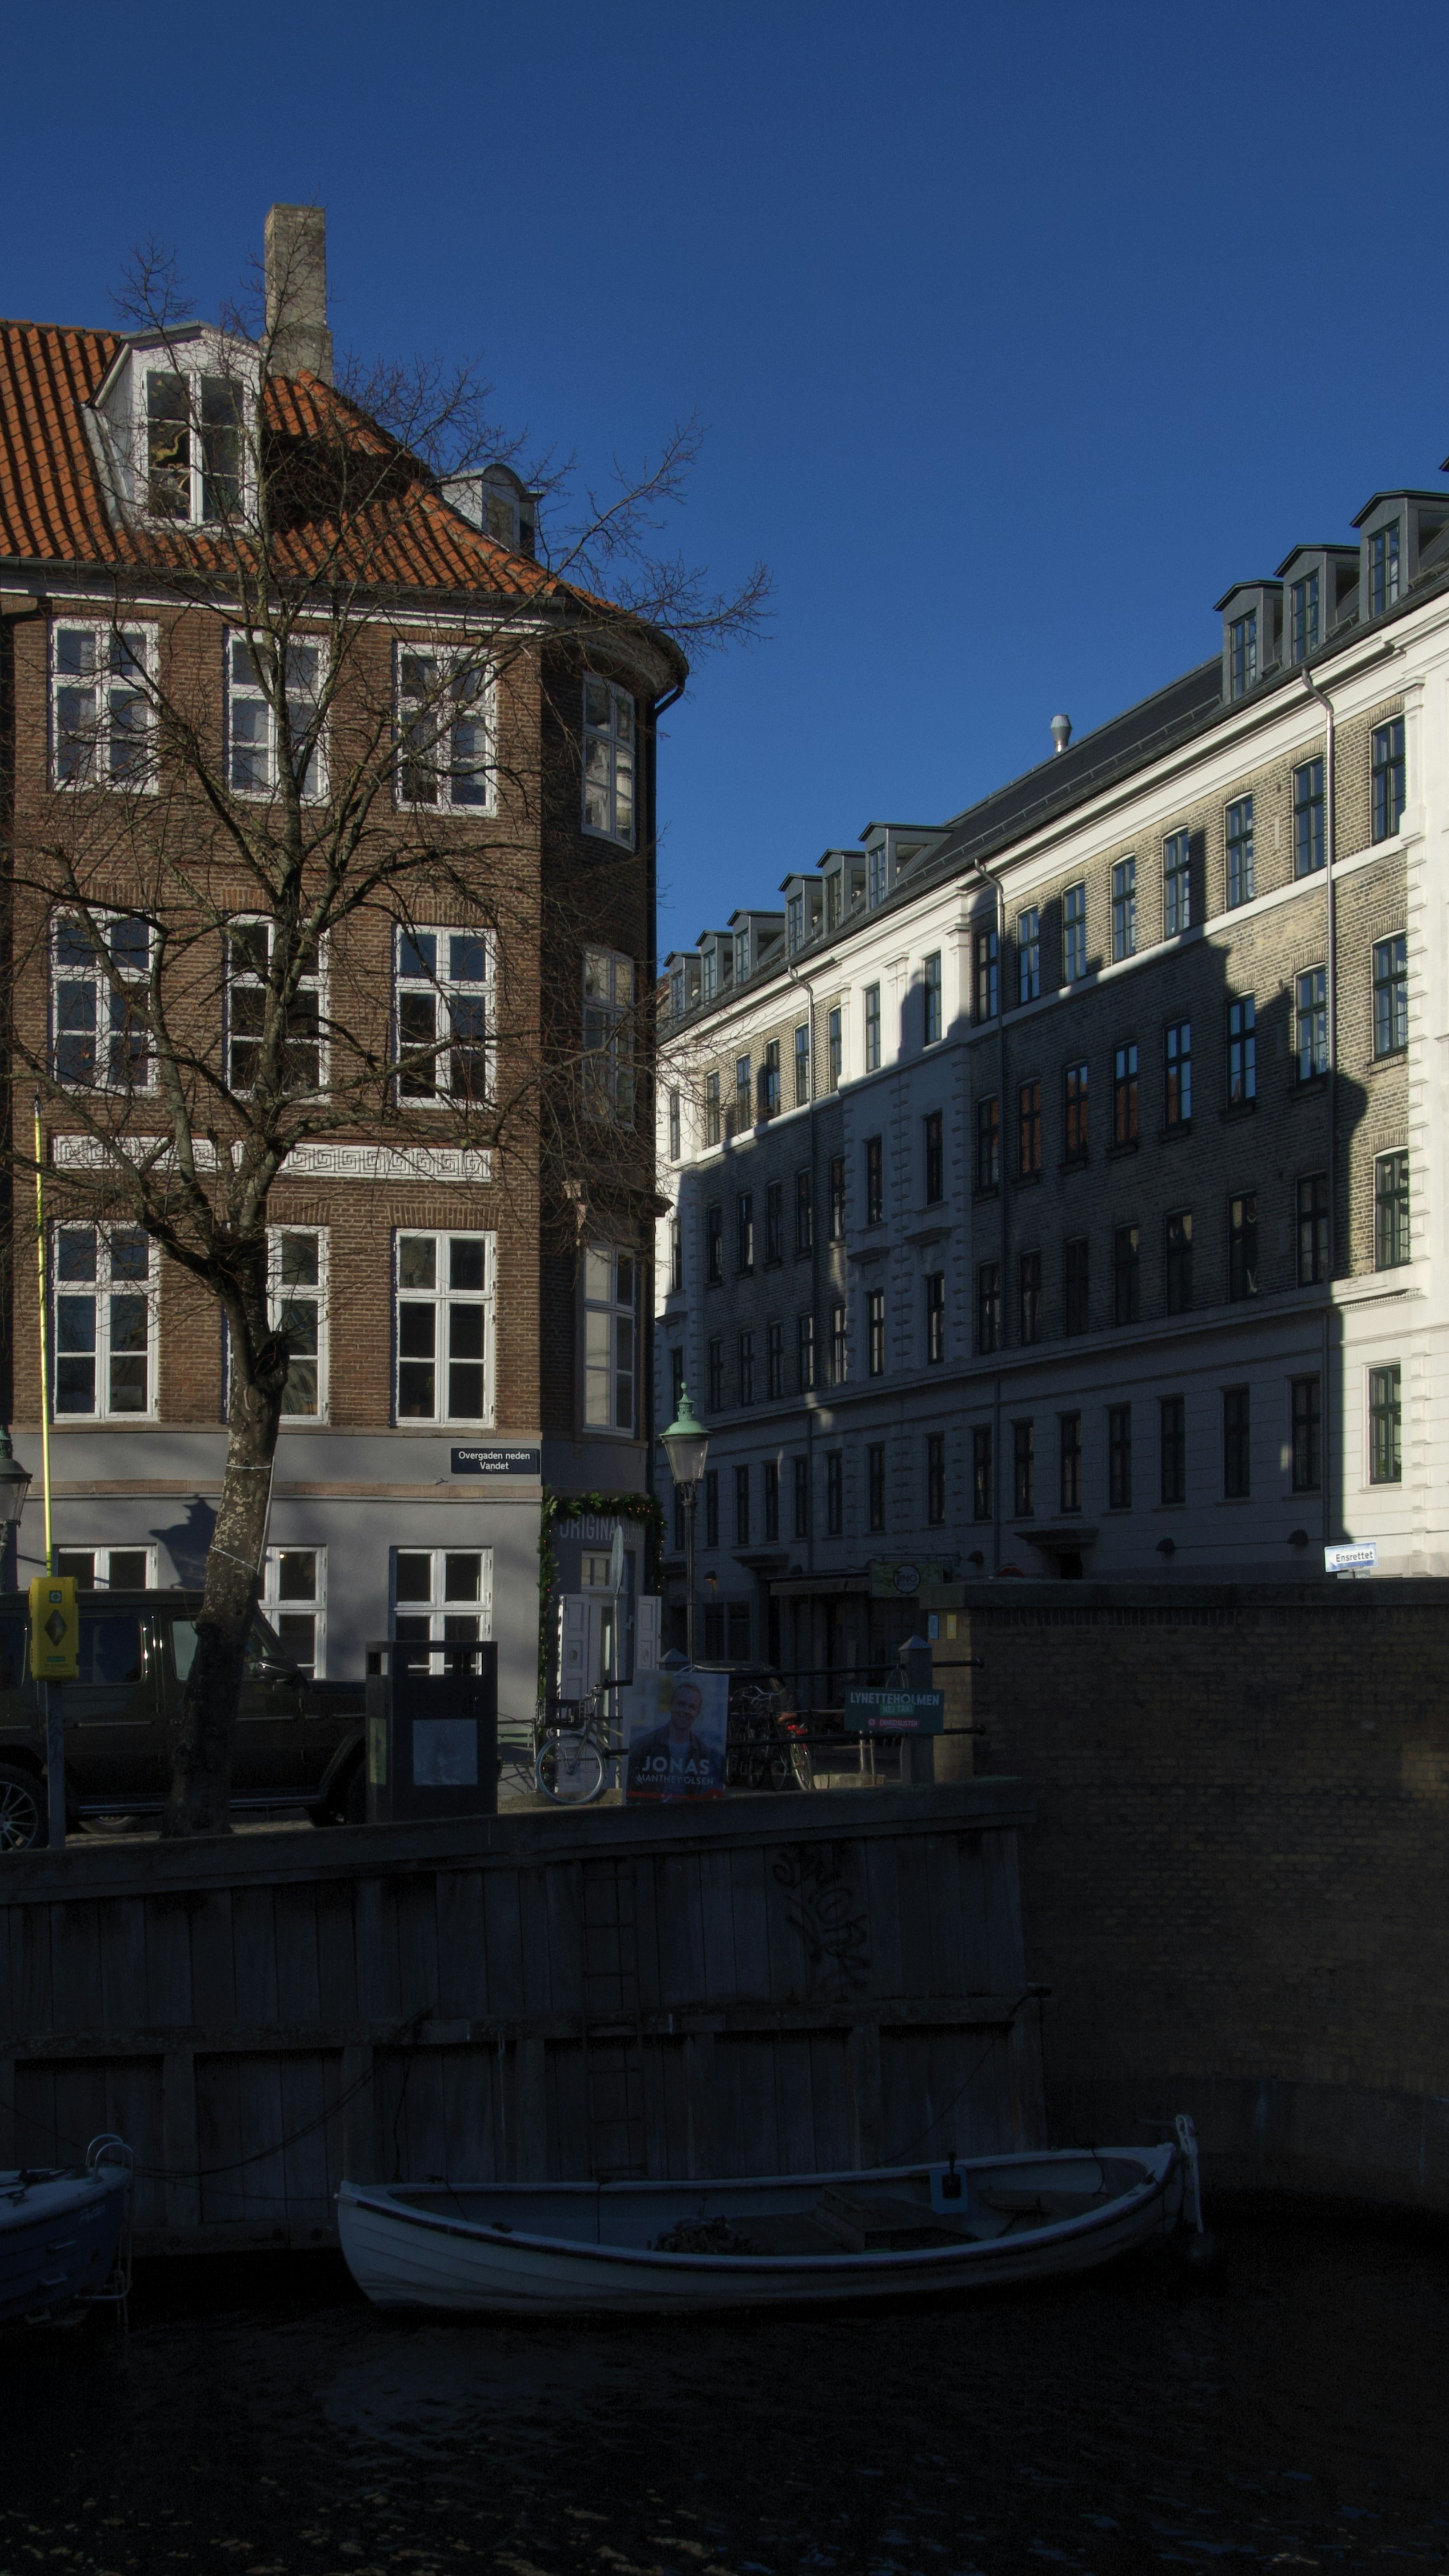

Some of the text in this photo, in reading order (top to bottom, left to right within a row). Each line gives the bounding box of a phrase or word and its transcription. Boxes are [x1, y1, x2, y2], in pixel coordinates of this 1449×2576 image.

[458, 1451, 530, 1461] Overgaden neden
[480, 1462, 509, 1470] Vandet
[1336, 1550, 1373, 1562] Ensrettet
[850, 1692, 939, 1706] LYNETTEHOLMEN
[642, 1755, 710, 1775] JONAS
[636, 1774, 714, 1785] MANTHEY OLSEN
